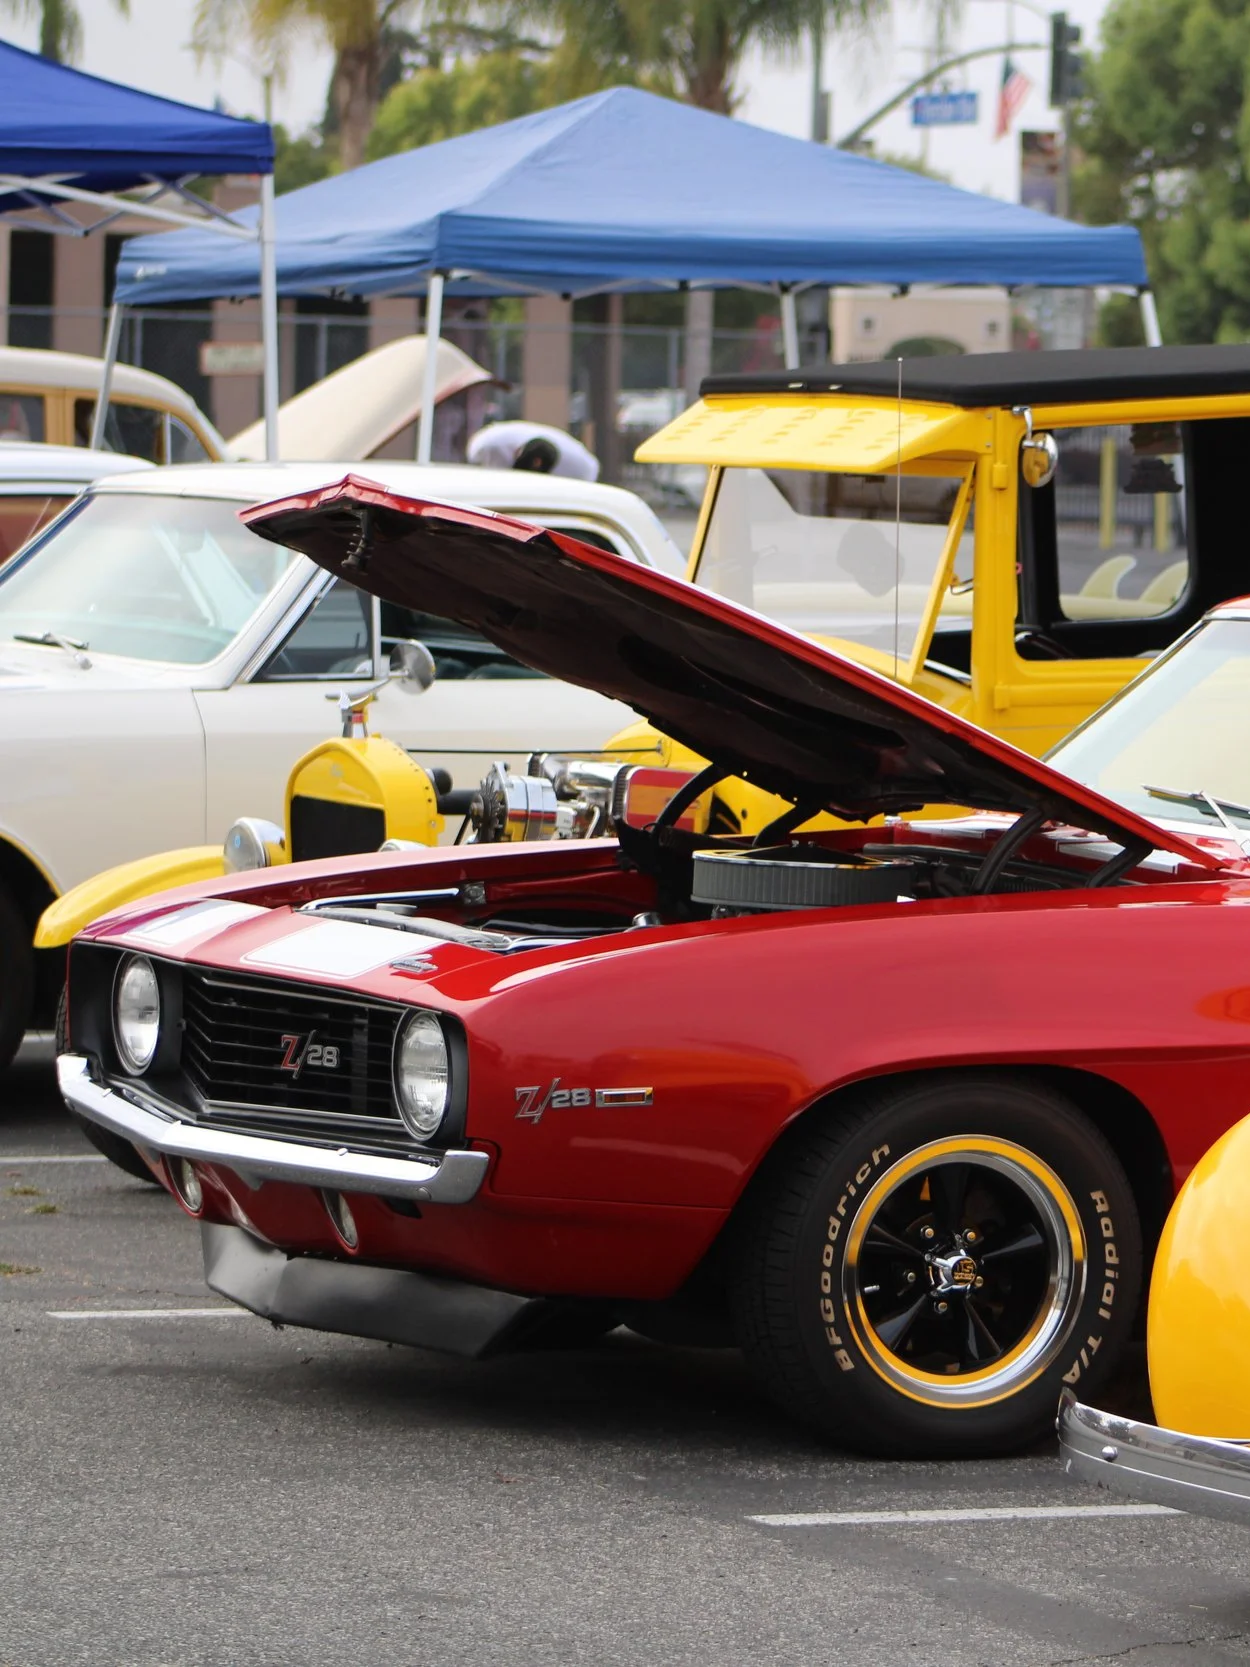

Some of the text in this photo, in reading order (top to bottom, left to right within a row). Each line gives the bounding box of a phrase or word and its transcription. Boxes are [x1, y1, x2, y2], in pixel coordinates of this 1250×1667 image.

[280, 1029, 341, 1080] Z/28
[514, 1077, 592, 1125] Z/28
[819, 1143, 892, 1372] BFGoodrich
[1061, 1189, 1121, 1385] Radial T/A
